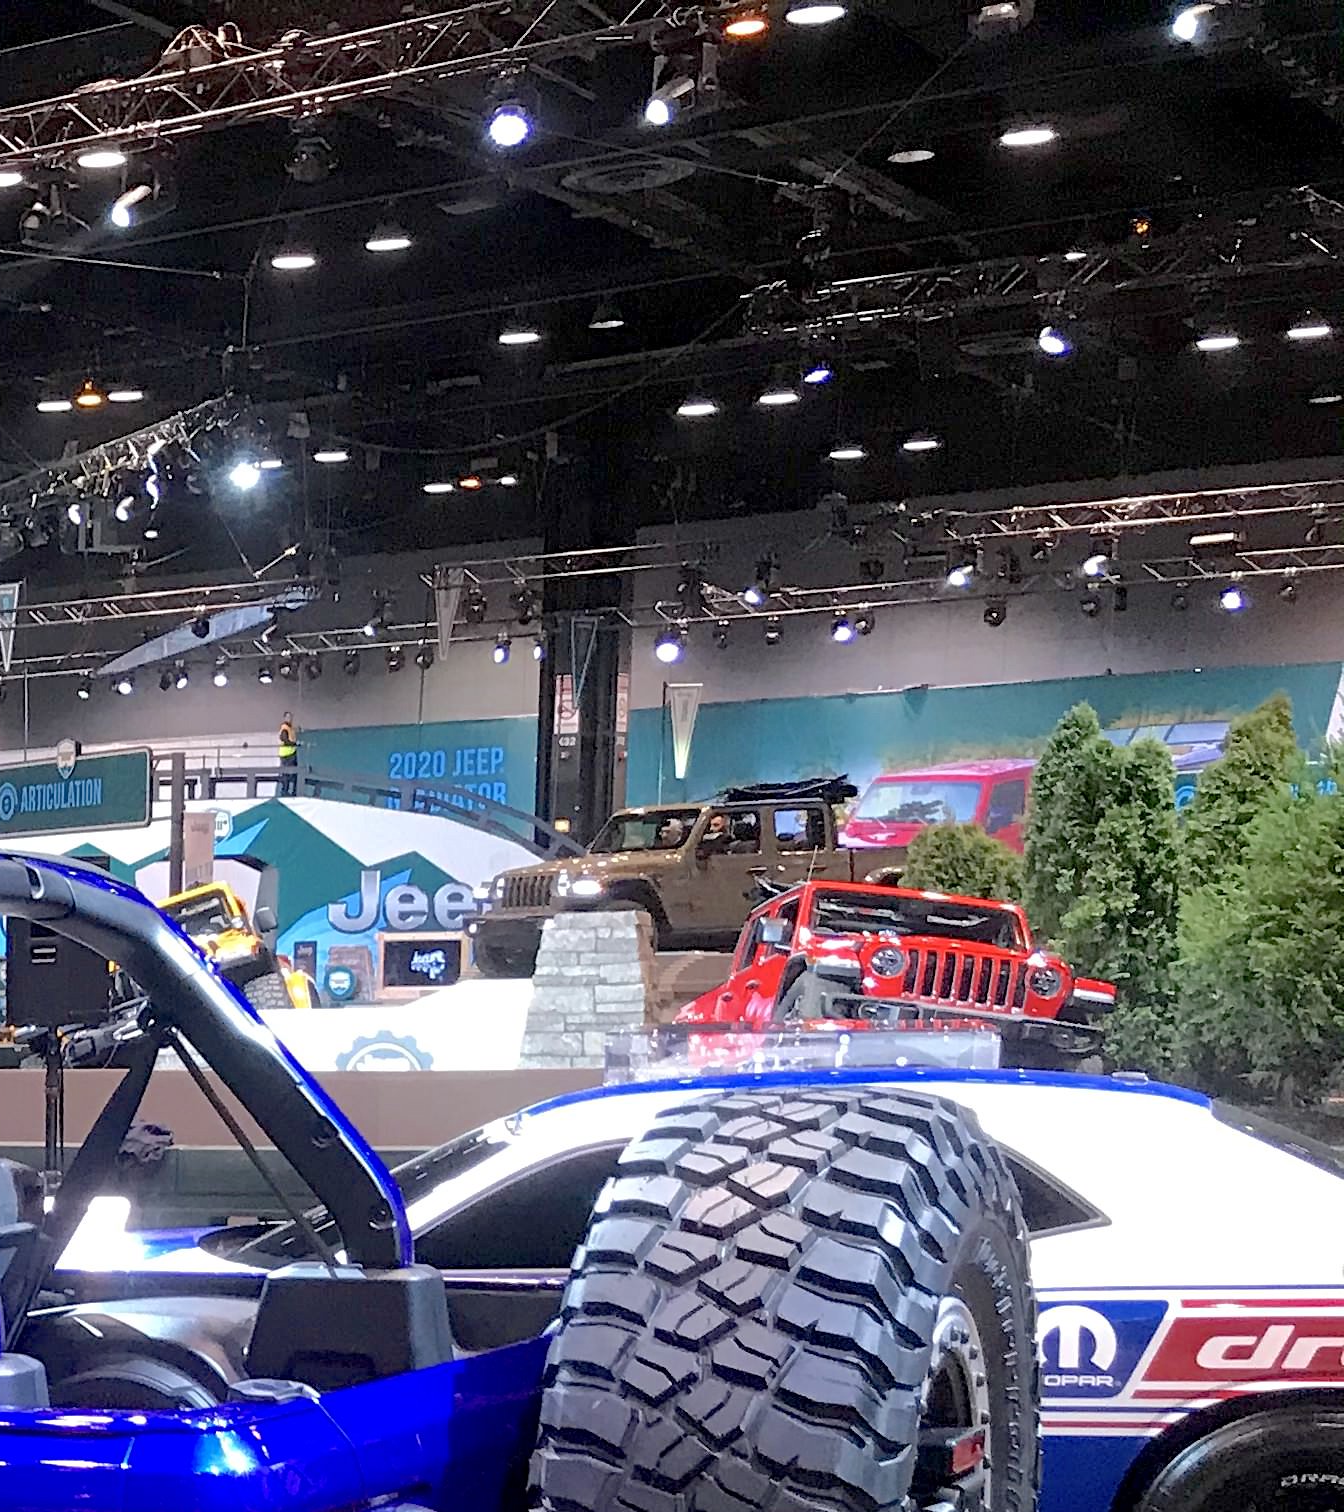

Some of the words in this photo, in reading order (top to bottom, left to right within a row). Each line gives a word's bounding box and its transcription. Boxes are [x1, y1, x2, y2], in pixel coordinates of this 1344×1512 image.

[390, 750, 445, 779] 2020
[452, 747, 504, 776] JEEP
[20, 778, 103, 813] ARTICULATION
[327, 870, 487, 932] Jee
[1196, 1324, 1344, 1369] dr
[1042, 1374, 1114, 1388] OPAR
